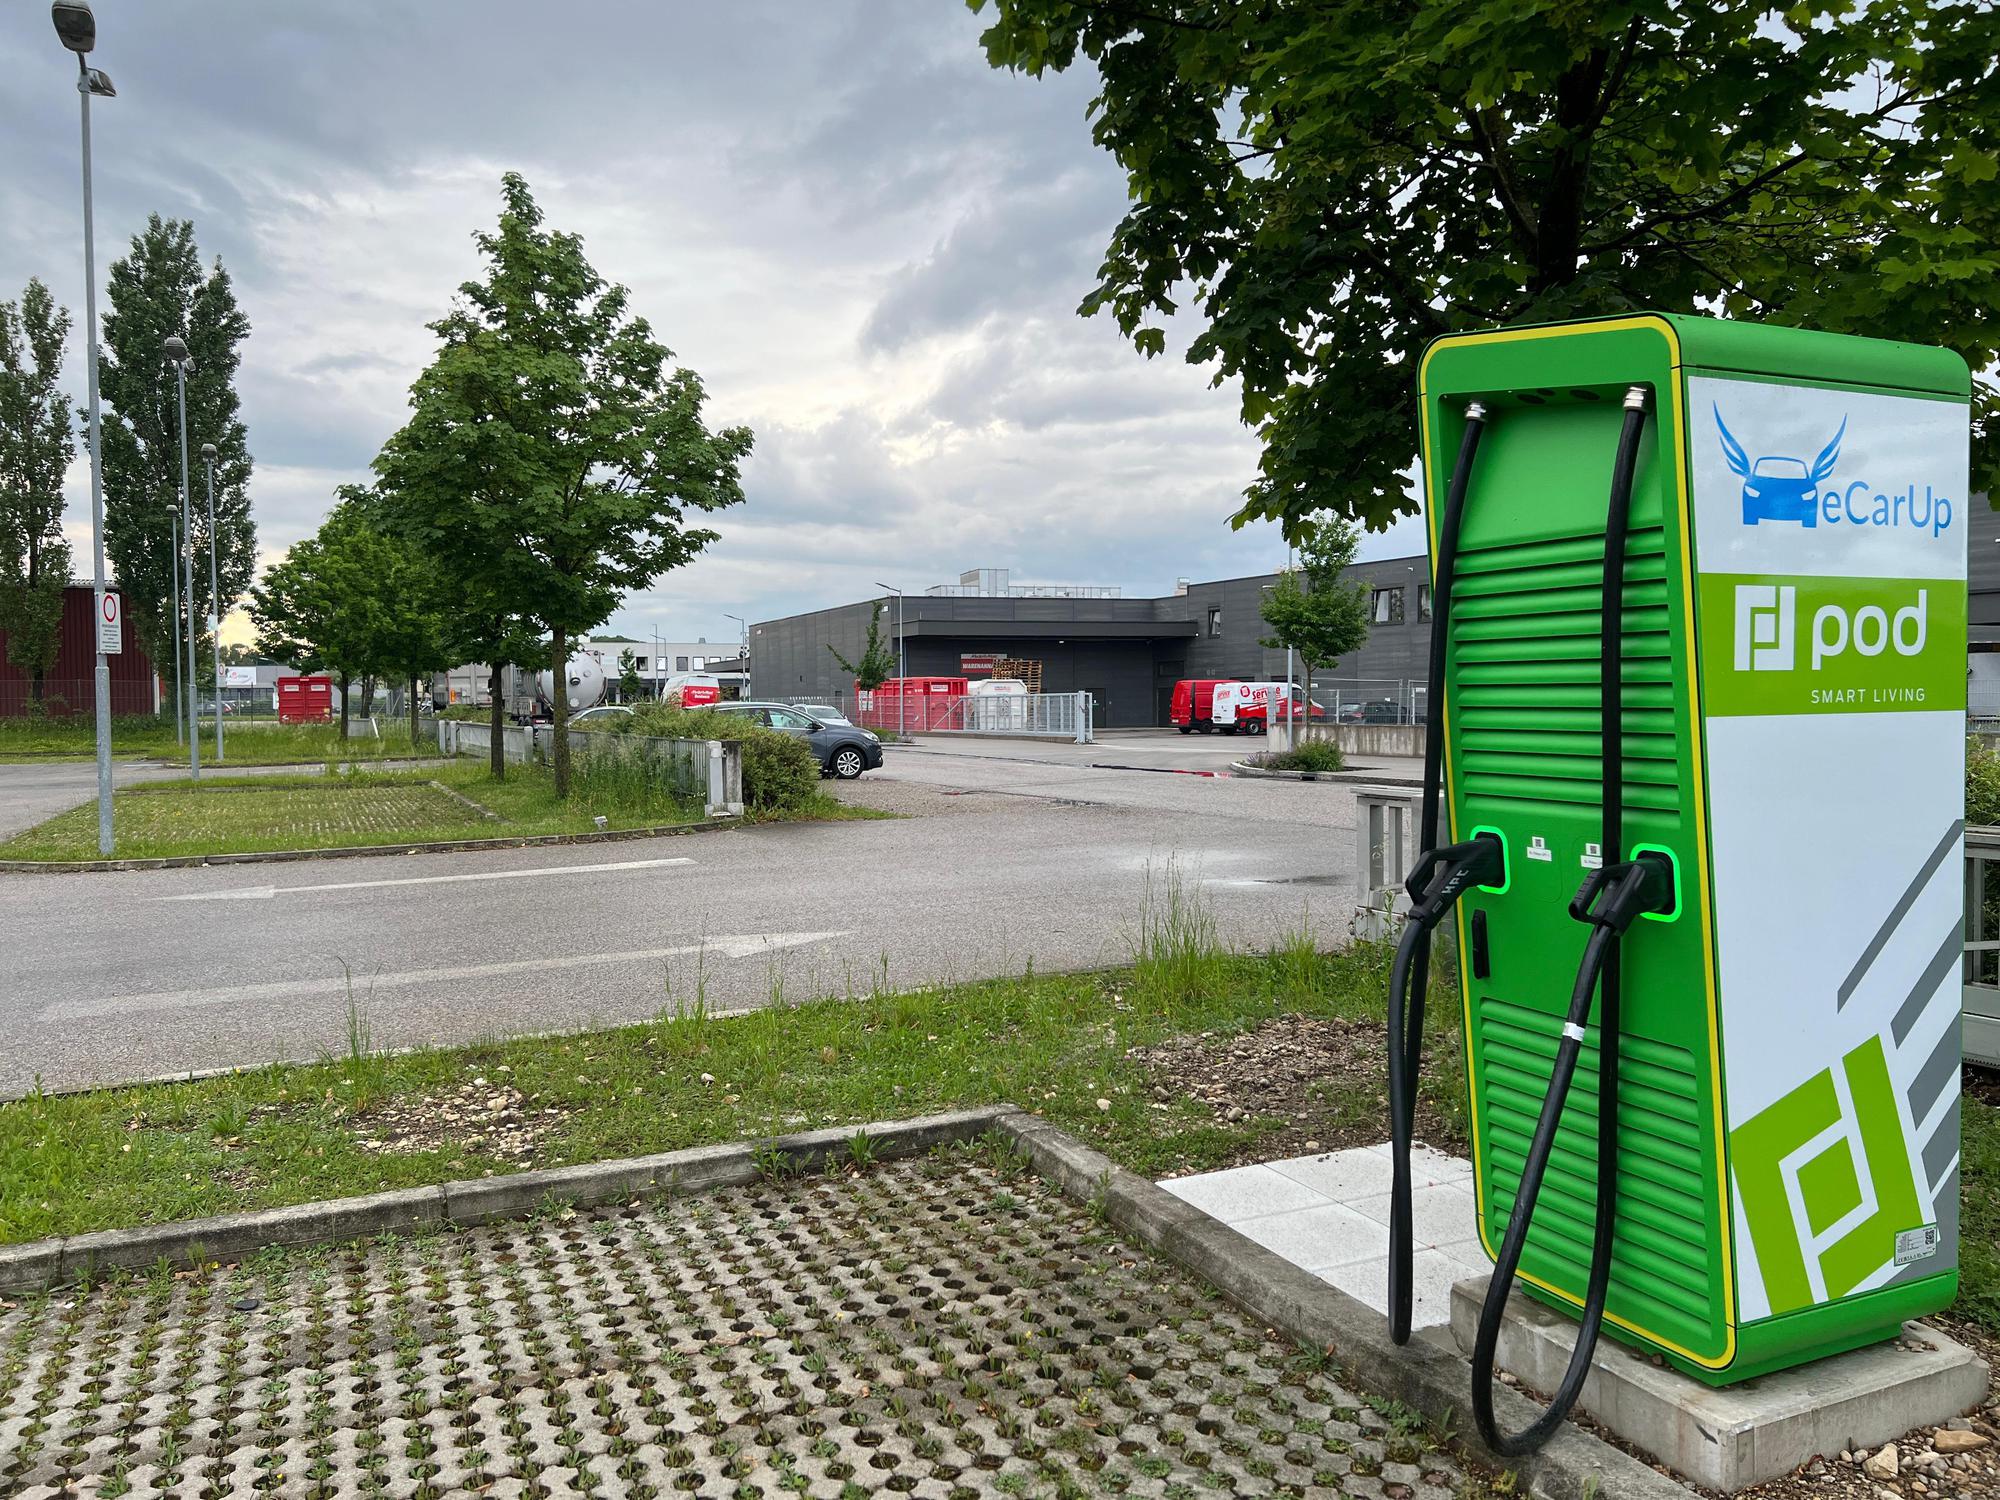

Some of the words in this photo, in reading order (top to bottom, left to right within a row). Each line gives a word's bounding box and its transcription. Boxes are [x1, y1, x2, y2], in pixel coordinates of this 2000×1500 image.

[1822, 481, 1952, 538] eCarUp
[1811, 589, 1928, 671] pod
[1811, 689, 1866, 704] SMART
[1873, 687, 1926, 702] LIVING
